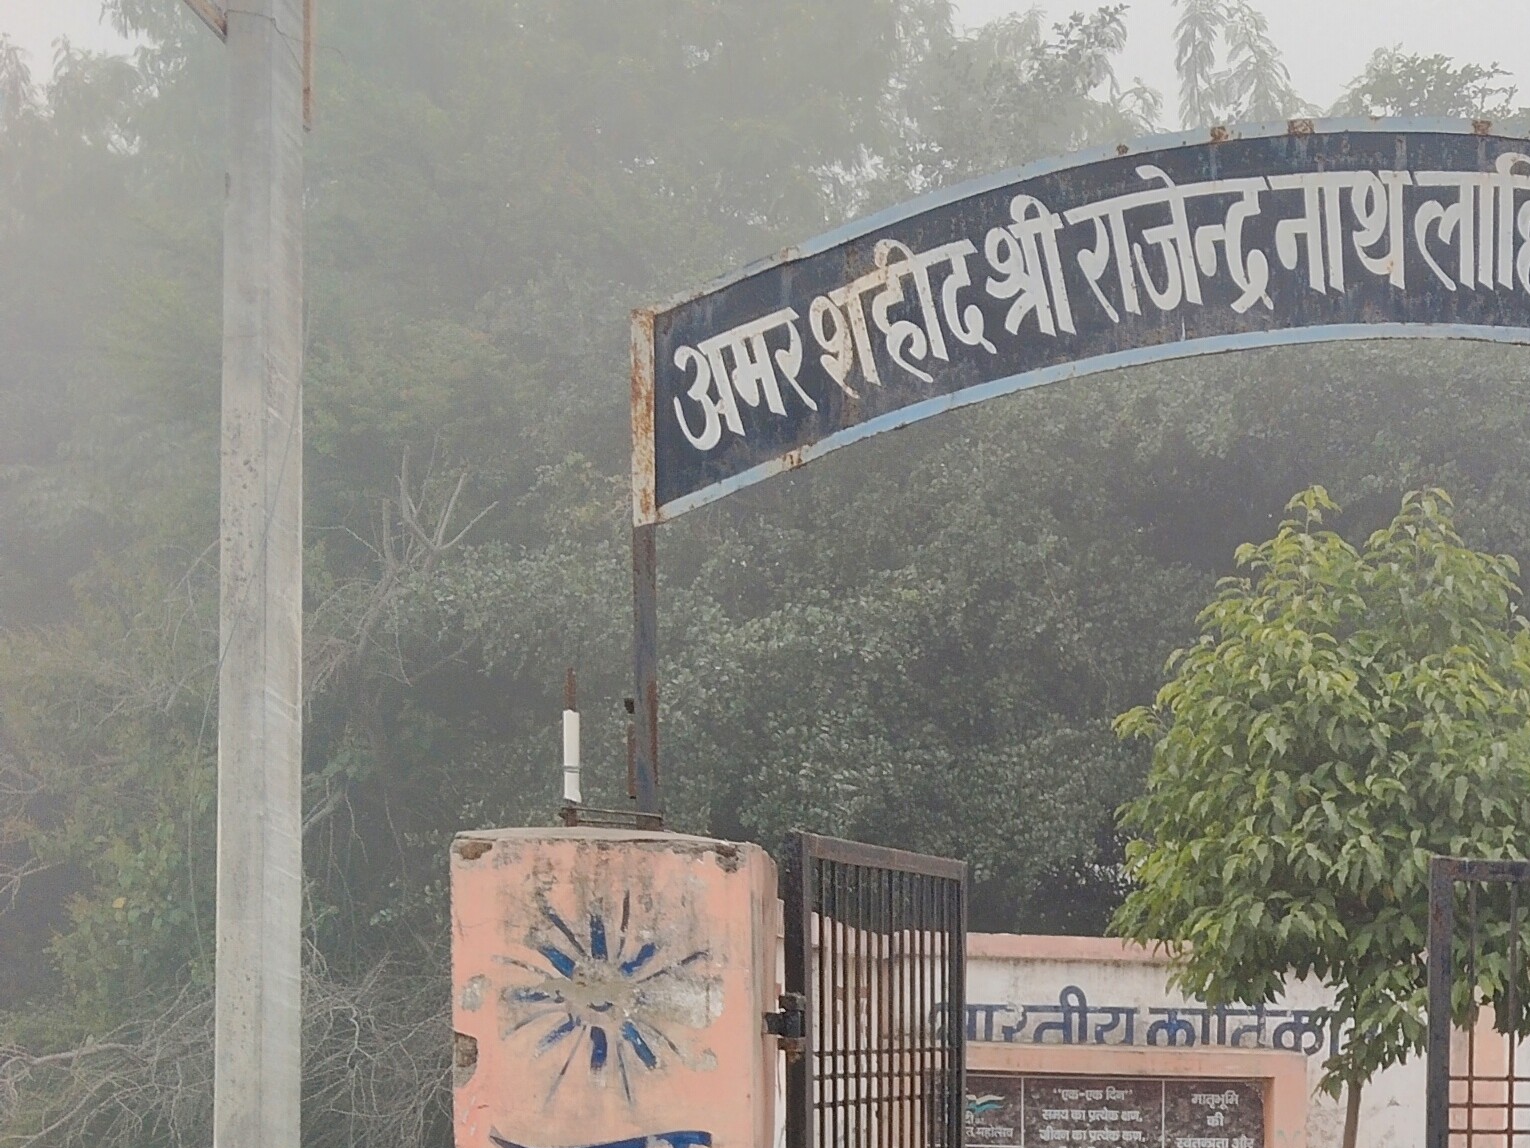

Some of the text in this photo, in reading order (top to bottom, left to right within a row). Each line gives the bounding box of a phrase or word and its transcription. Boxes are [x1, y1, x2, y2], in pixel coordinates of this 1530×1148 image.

[675, 307, 817, 450] अमर
[809, 238, 997, 398] शहीद
[984, 194, 1077, 337] श्री
[1066, 164, 1274, 324] राजेन्द्र
[1268, 170, 1412, 293] नाथ
[1042, 1109, 1069, 1121] समय
[1071, 1109, 1086, 1121] का
[1206, 1111, 1224, 1127] की
[1039, 1126, 1070, 1141] जीवन
[1072, 1129, 1087, 1141] का
